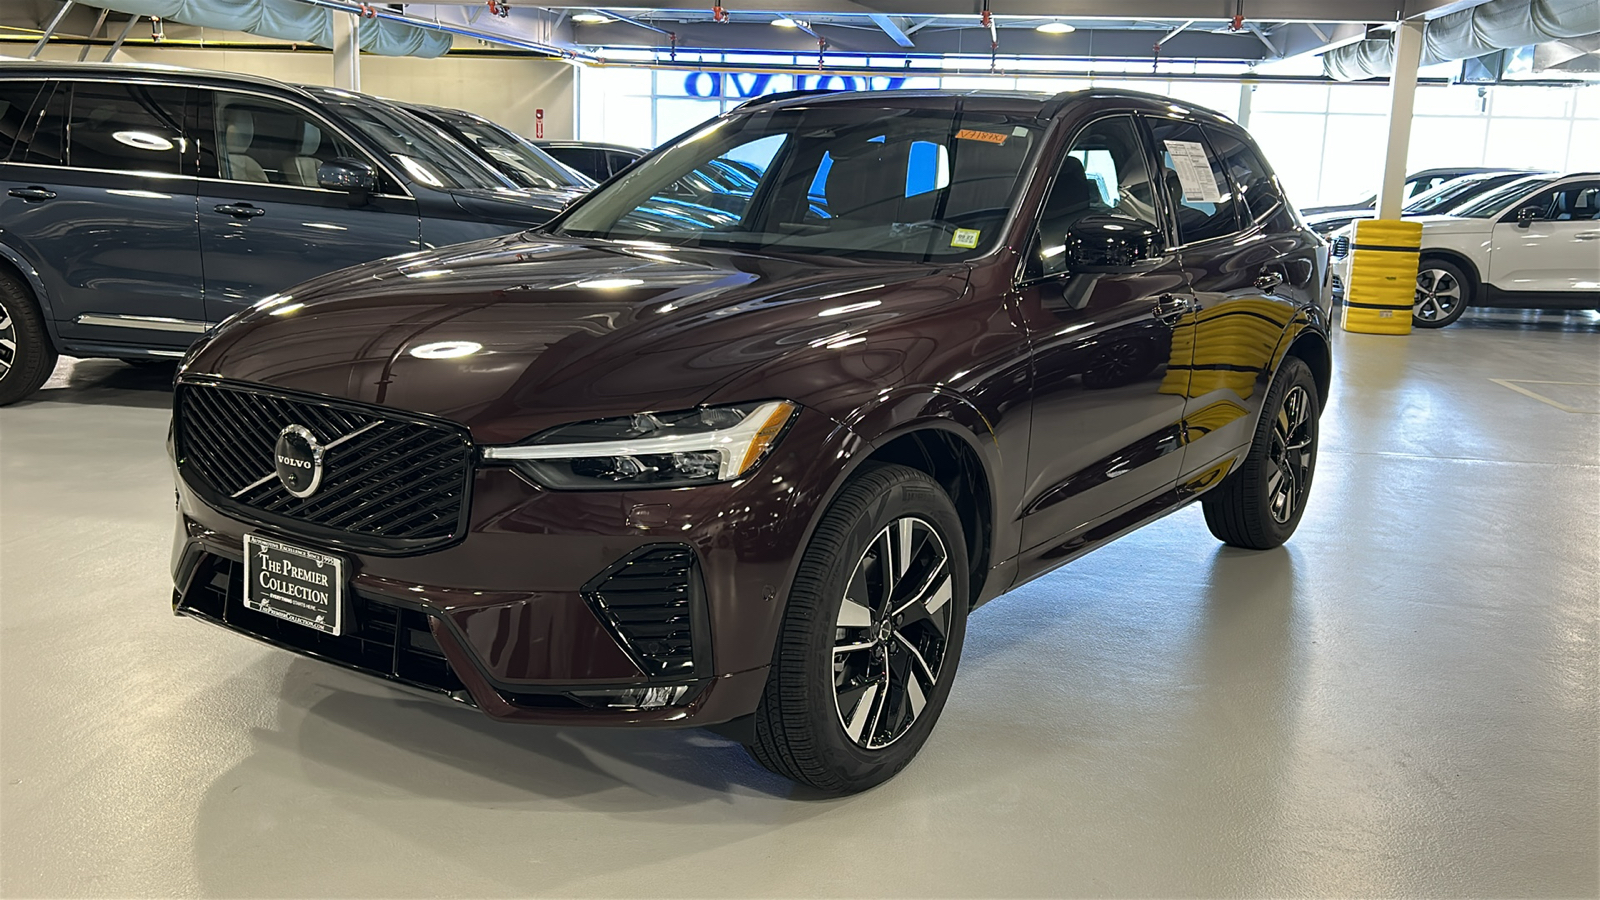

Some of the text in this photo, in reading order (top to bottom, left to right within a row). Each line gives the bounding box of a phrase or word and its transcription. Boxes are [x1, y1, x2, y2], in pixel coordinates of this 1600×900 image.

[277, 454, 312, 469] VOLVO
[260, 553, 329, 587] THE PREMIER
[259, 571, 329, 606] COLLECTION
